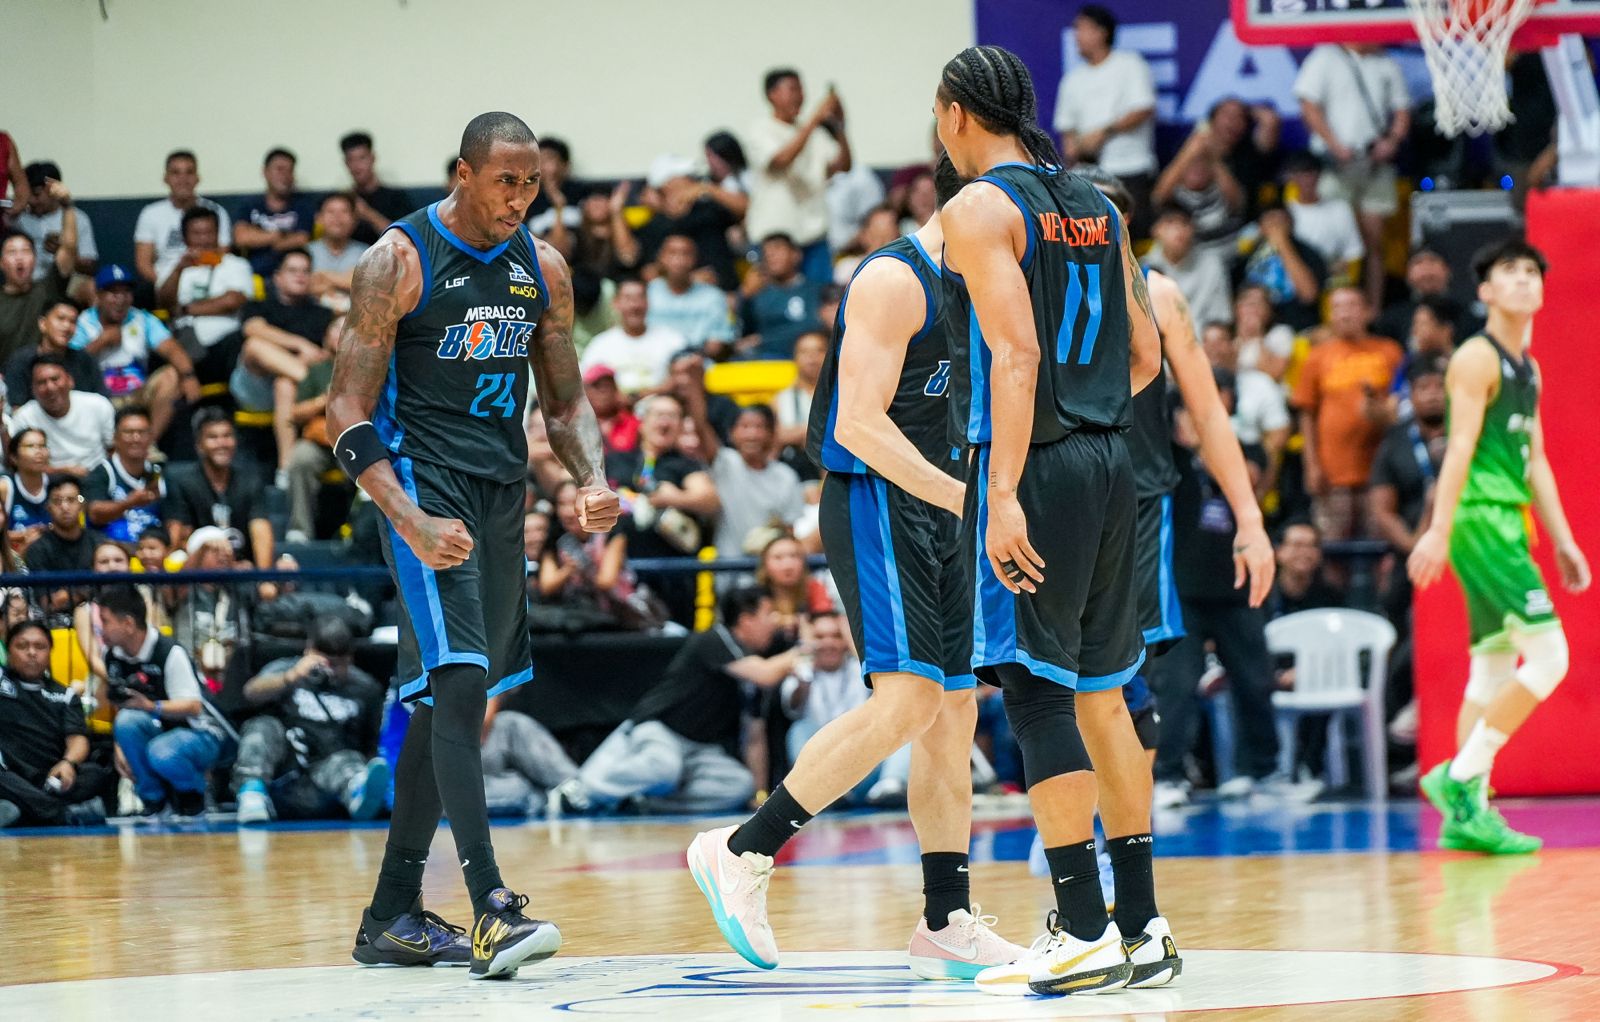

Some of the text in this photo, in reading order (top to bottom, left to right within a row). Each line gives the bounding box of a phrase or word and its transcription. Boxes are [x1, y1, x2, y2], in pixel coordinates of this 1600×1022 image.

[463, 306, 525, 322] MERALCO
[1056, 261, 1103, 365] 11
[437, 320, 536, 361] BOLTS
[469, 372, 516, 417] 24
